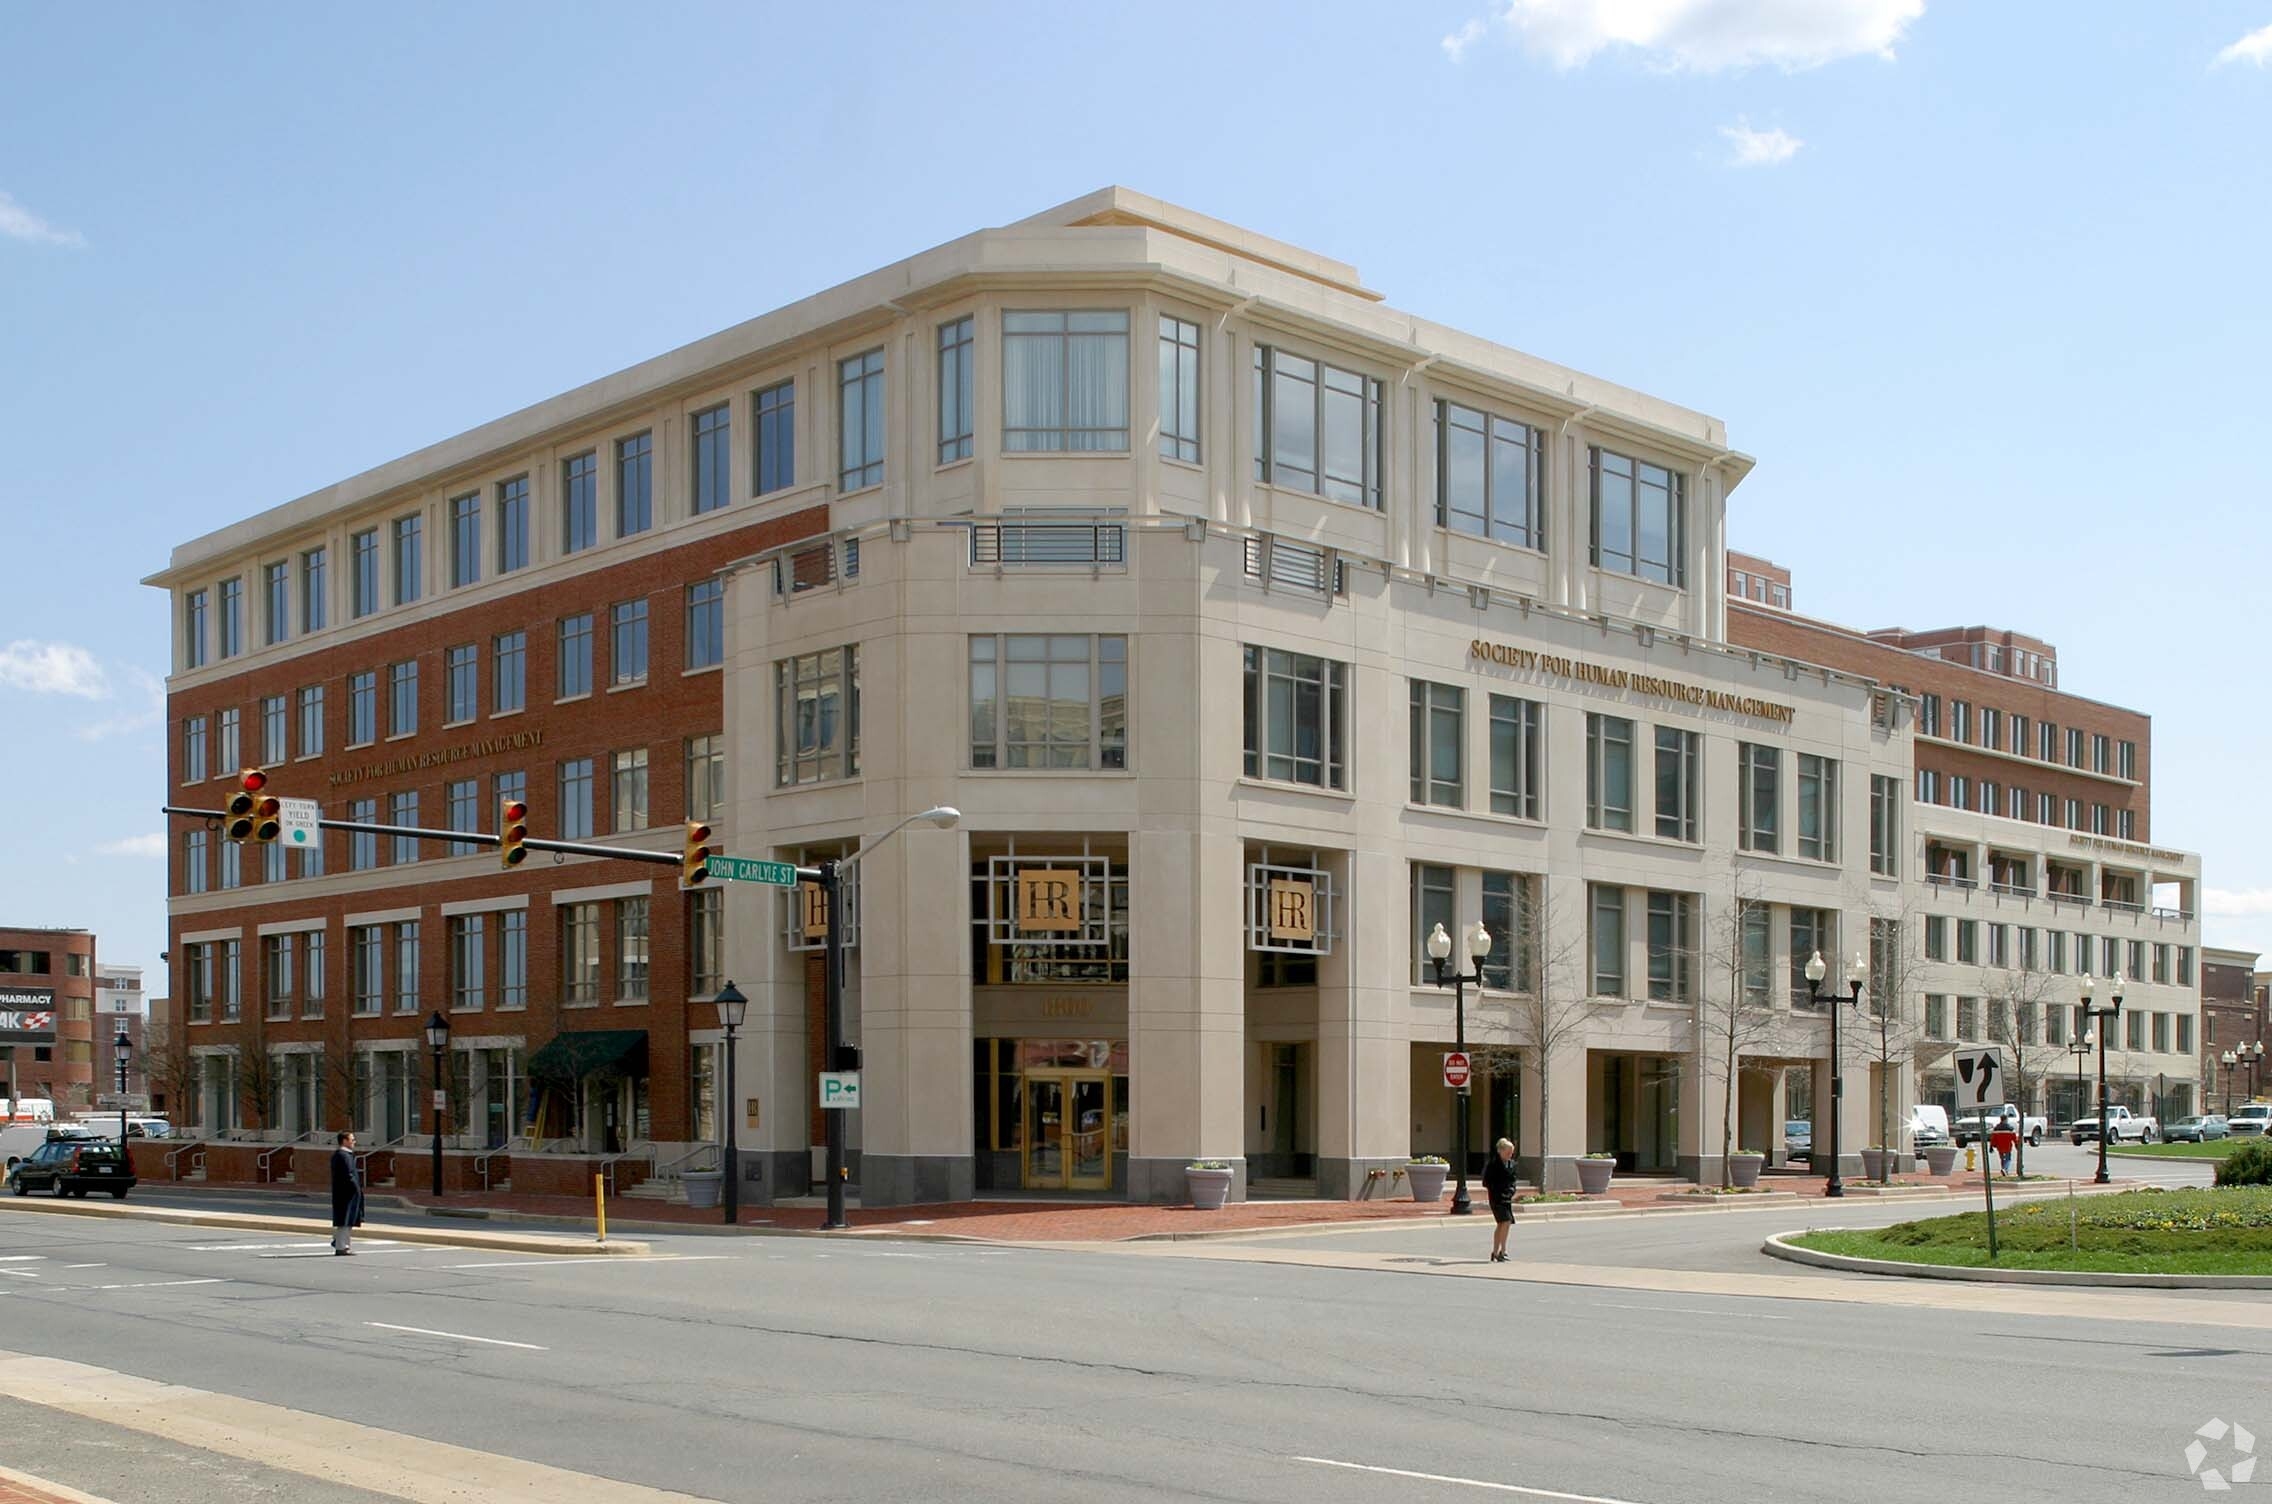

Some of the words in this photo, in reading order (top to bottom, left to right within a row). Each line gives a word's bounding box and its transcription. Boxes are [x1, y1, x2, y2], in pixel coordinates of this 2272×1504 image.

[1471, 639, 1538, 671] SOCIETY
[1541, 653, 1572, 678] FOR
[1575, 661, 1629, 689] HUMAN
[1631, 673, 1705, 705] RESOURCE
[1706, 689, 1796, 724] MANAGEMENT
[329, 766, 363, 785] SOCIETY
[366, 764, 383, 778] FOR
[385, 755, 418, 775] HUMAN
[420, 744, 469, 768] RESOURCE
[471, 727, 543, 758] MANAGEMENT
[288, 810, 310, 819] YIELD
[708, 859, 735, 876] JOHN
[739, 863, 777, 881] CARLYLE
[780, 867, 793, 883] ST
[808, 886, 828, 927] H
[1025, 880, 1073, 920] HR
[1276, 890, 1307, 930] HR
[0, 994, 52, 1004] HARMACY
